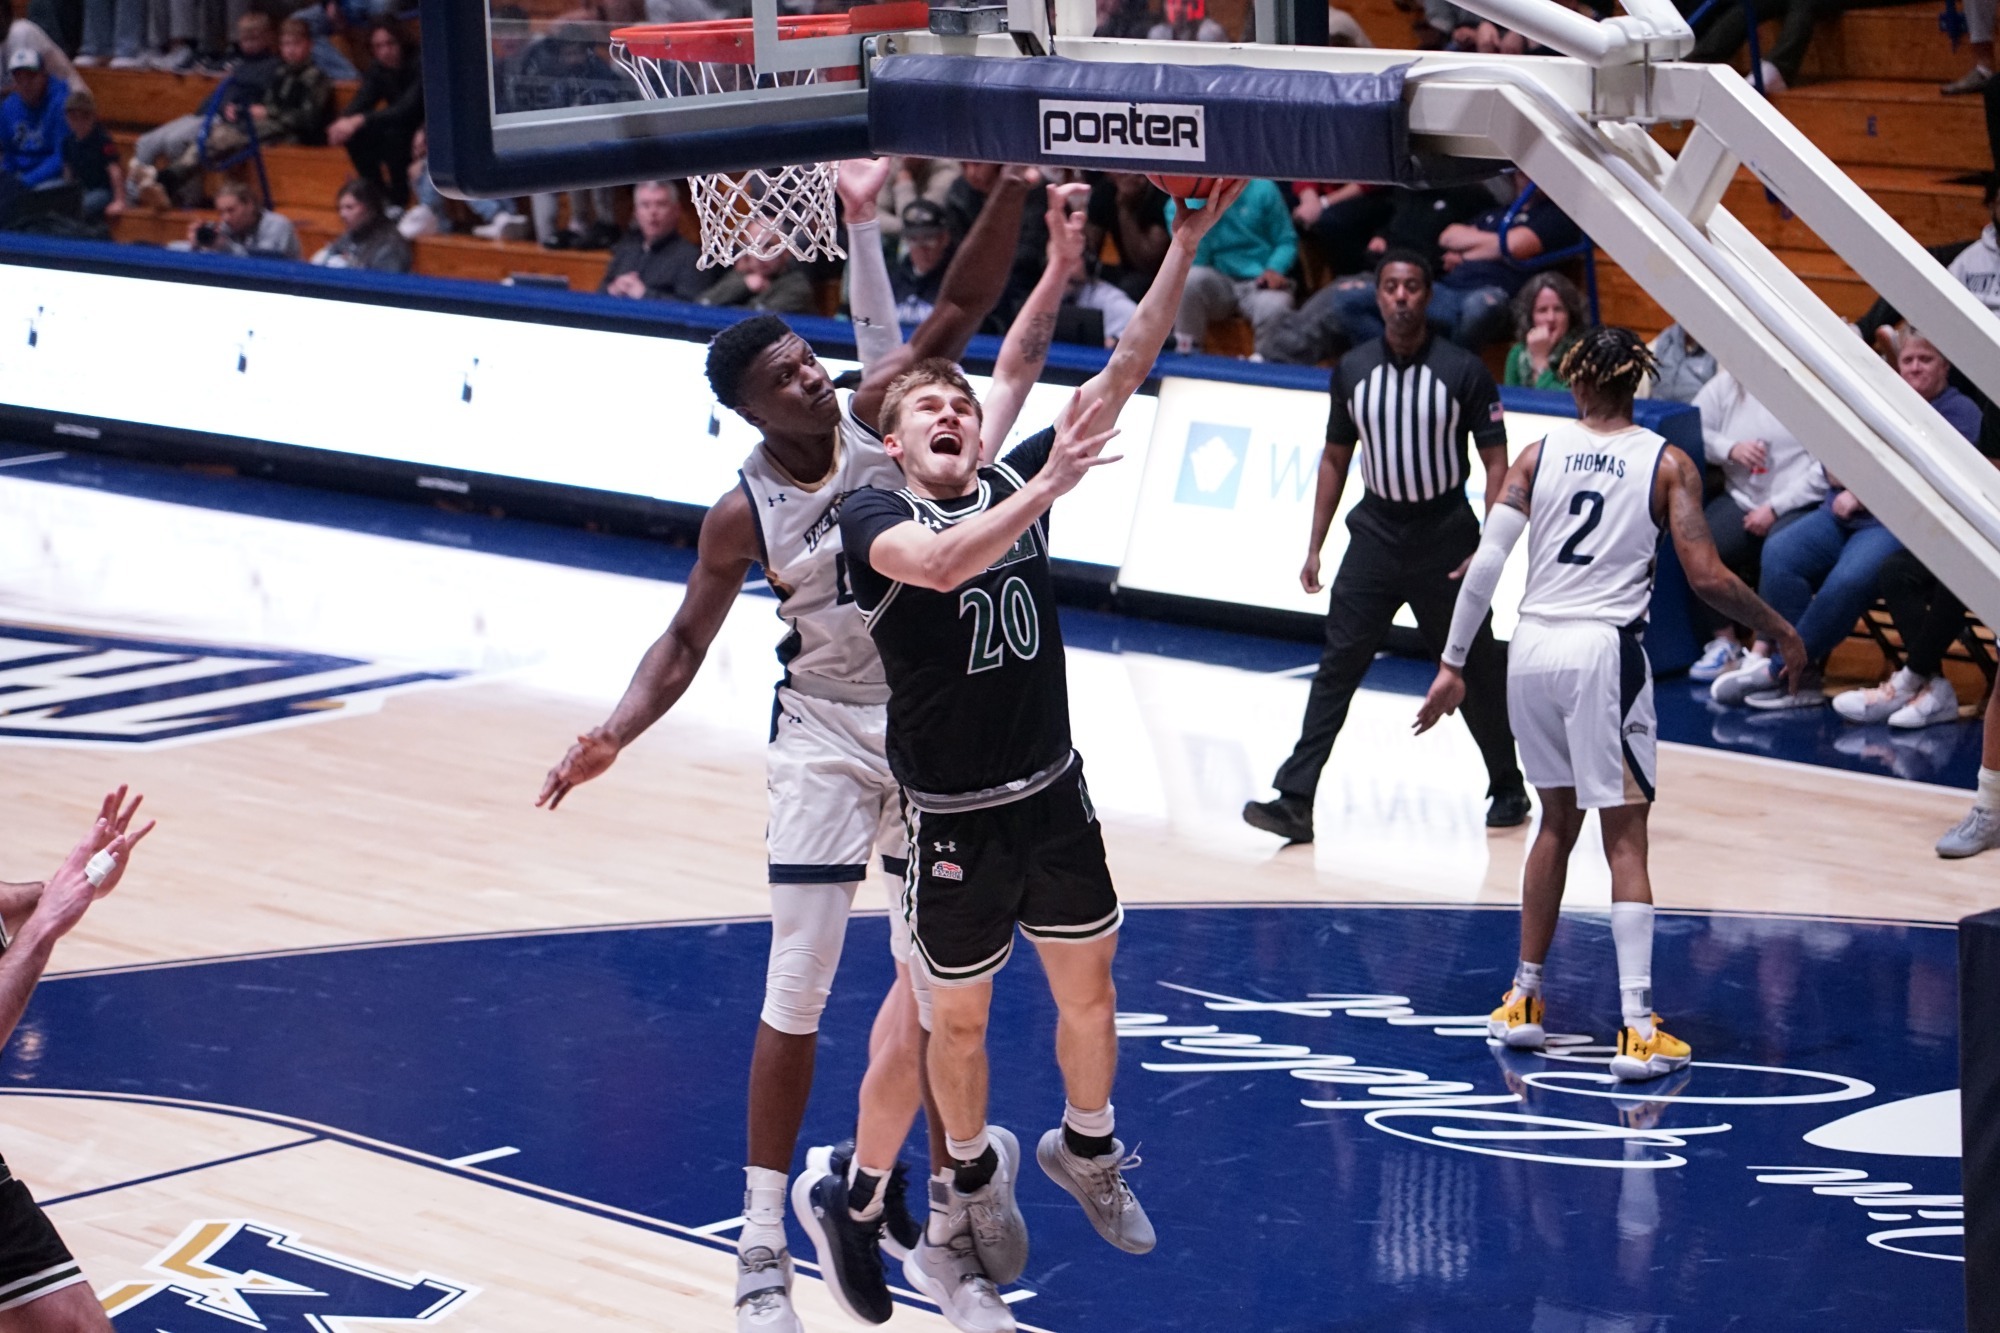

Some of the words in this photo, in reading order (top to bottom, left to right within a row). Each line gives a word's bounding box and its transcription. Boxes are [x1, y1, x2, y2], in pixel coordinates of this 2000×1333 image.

[1565, 453, 1626, 479] THOMAS
[1557, 490, 1604, 566] 2
[959, 576, 1039, 675] 20
